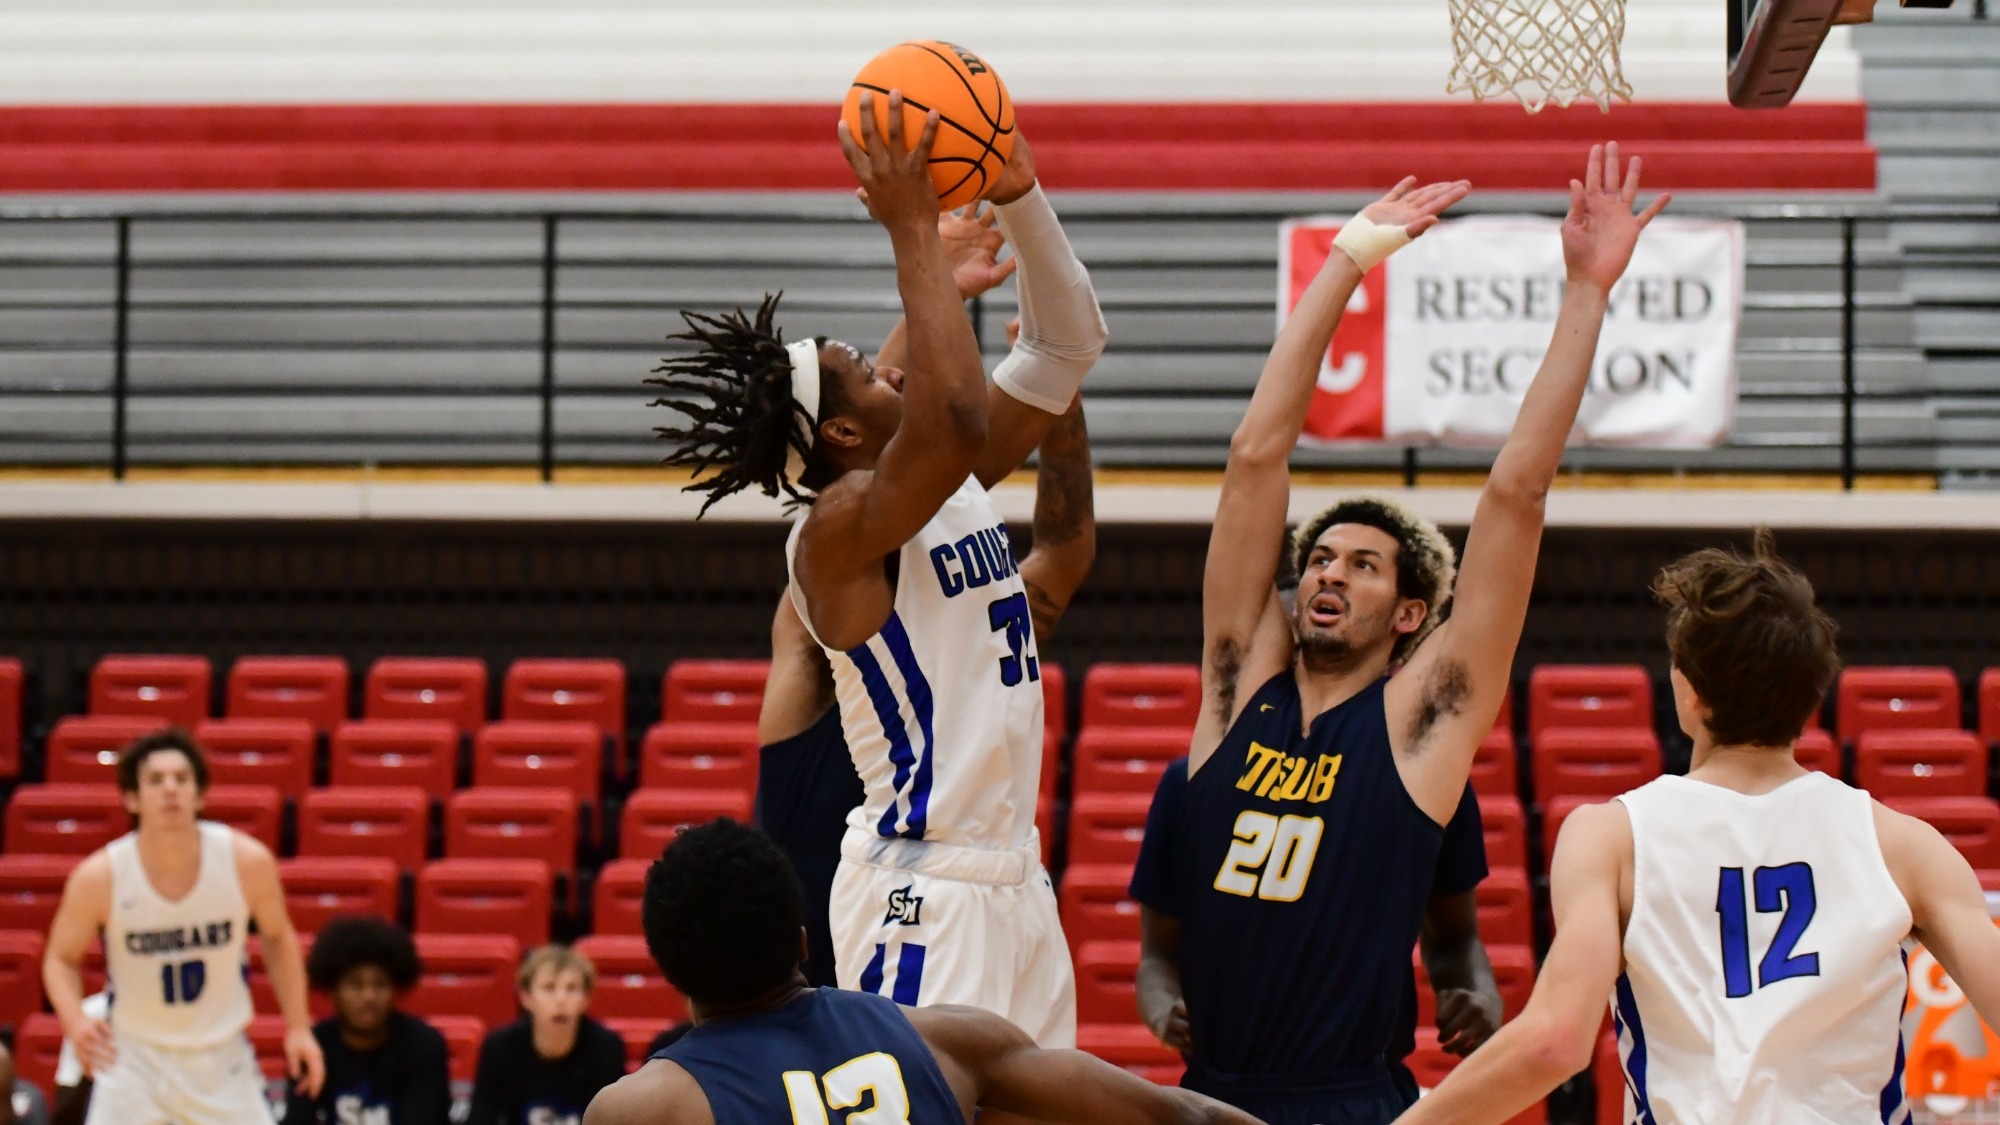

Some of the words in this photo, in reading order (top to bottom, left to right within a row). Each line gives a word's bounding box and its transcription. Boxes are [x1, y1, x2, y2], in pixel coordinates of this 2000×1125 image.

[1414, 275, 1714, 322] RESEVED
[1425, 346, 1698, 396] SECON
[1213, 810, 1325, 903] 20
[1715, 861, 1820, 999] 12
[162, 960, 206, 1004] 10
